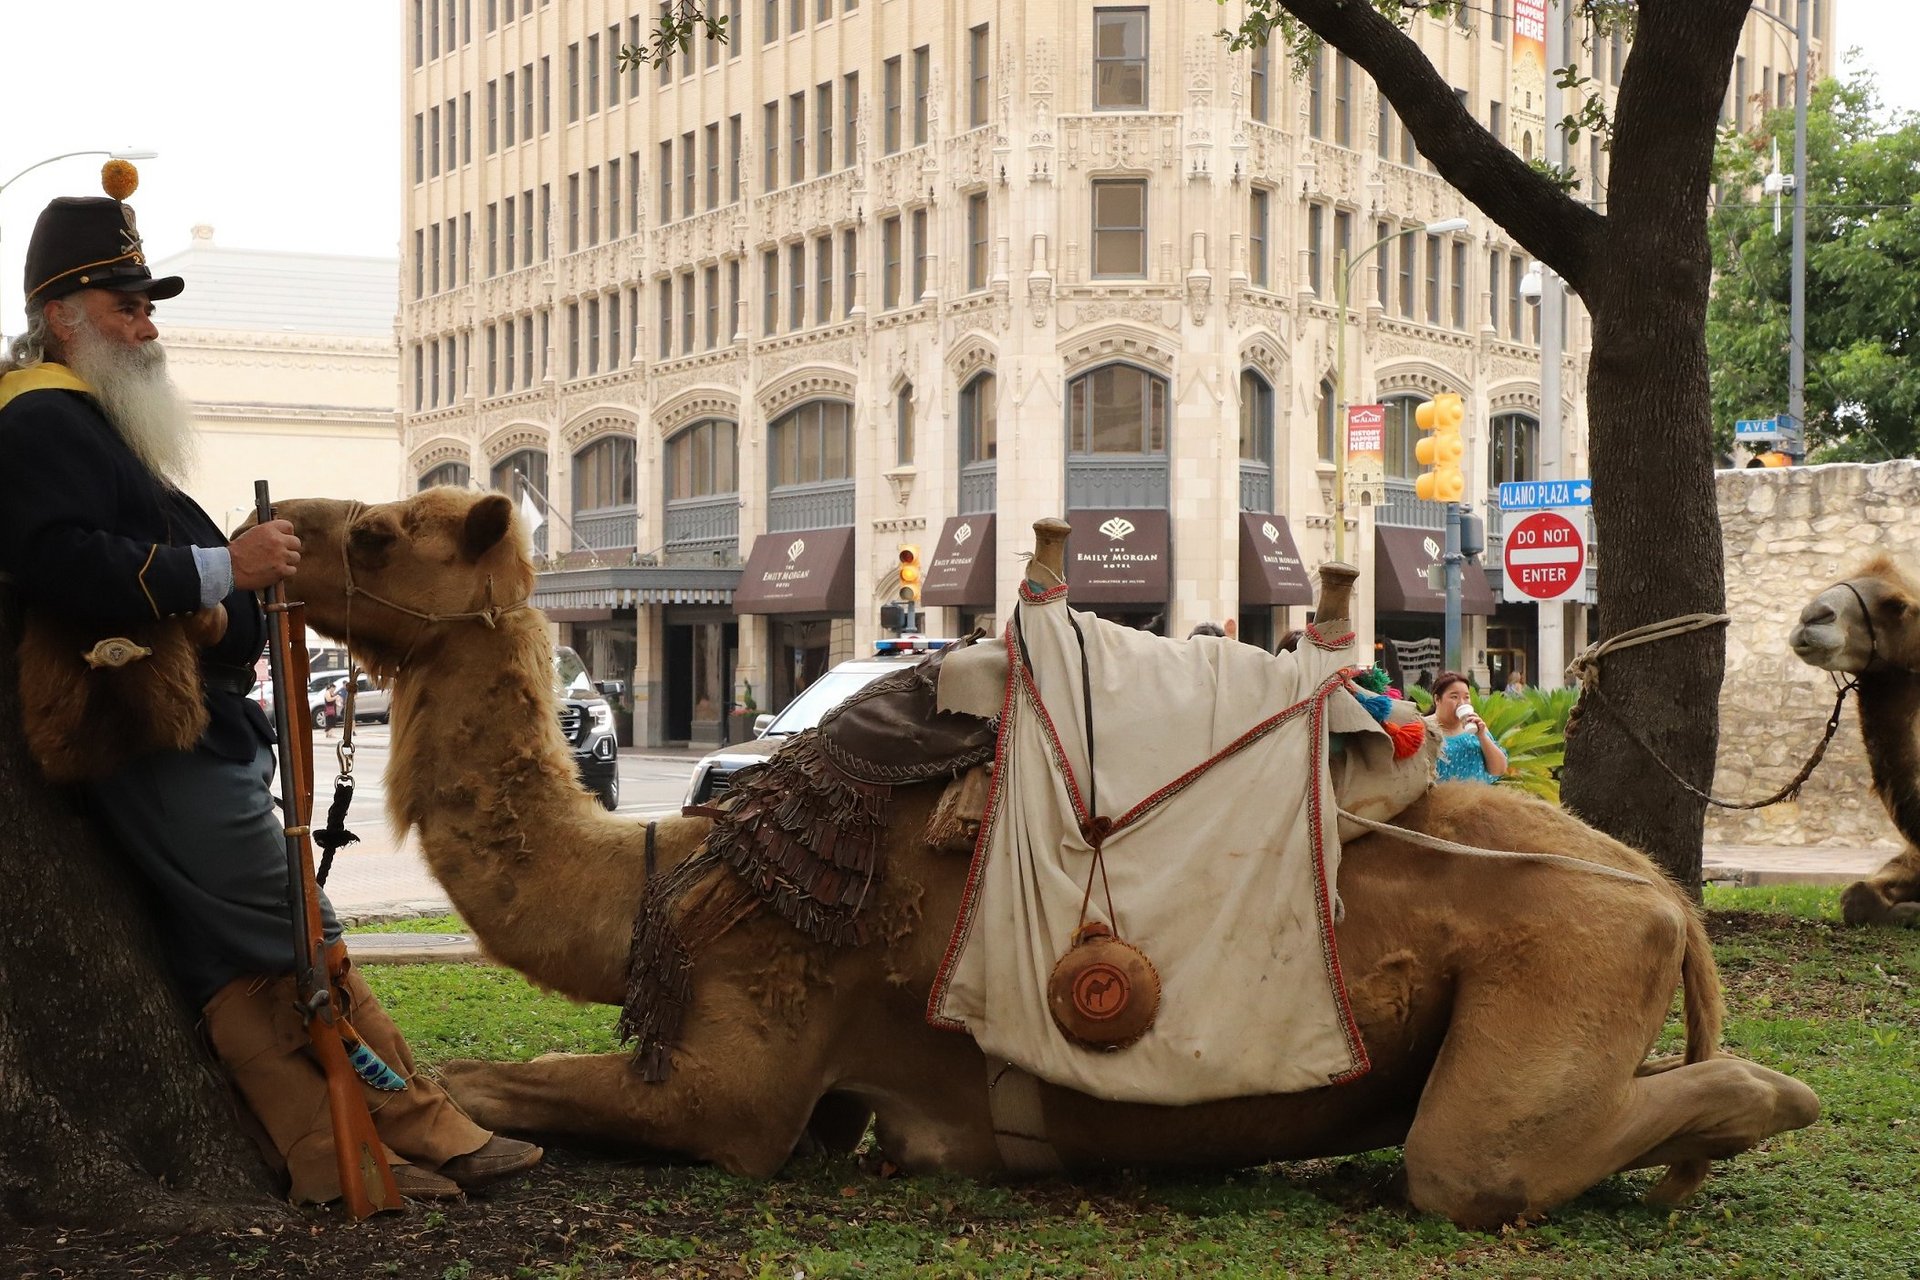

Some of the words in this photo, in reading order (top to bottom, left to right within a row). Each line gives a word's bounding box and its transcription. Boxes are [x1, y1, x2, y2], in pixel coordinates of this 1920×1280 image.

[1516, 14, 1544, 42] HERE
[133, 255, 142, 266] 2
[1744, 422, 1768, 431] AVE
[1350, 441, 1380, 451] HERE
[1502, 485, 1535, 506] ALAMO
[1539, 484, 1569, 504] PLAZA
[1517, 530, 1536, 544] DO
[1543, 528, 1570, 543] NOT
[1077, 553, 1108, 561] EMILY
[1112, 553, 1158, 561] MORGAN
[763, 572, 783, 581] EMILY
[782, 570, 810, 580] MORGAN
[1522, 567, 1566, 583] ENTER
